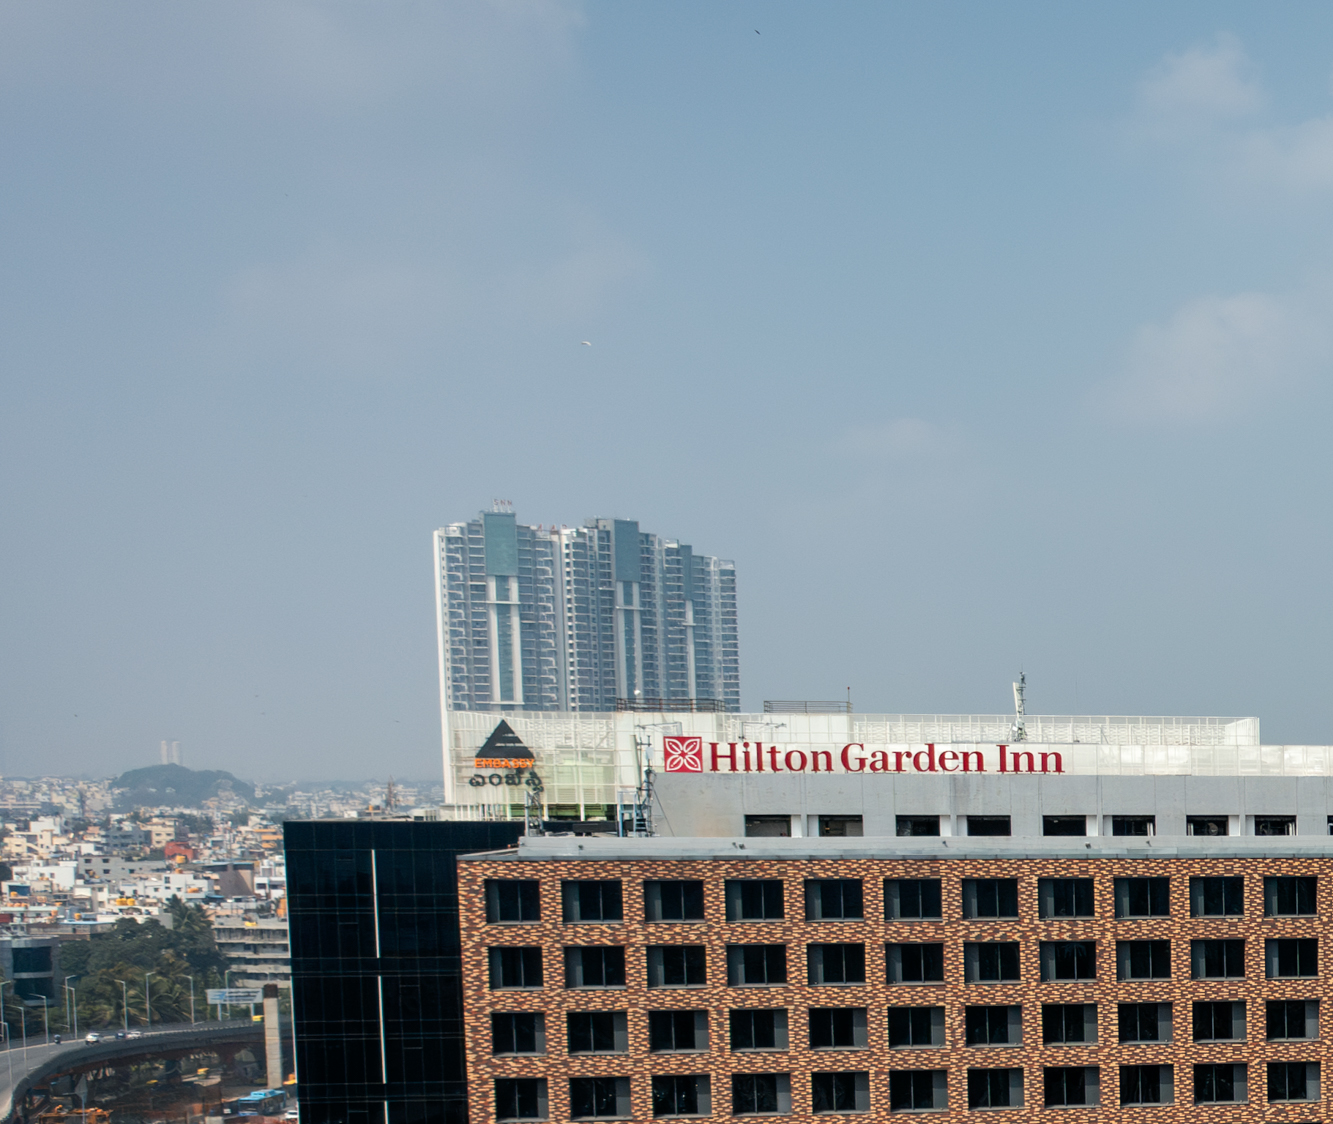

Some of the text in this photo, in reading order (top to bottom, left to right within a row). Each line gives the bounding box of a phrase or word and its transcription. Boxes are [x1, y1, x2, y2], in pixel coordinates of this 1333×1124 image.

[475, 758, 535, 768] EMBASSY
[709, 741, 1065, 773] Hilton Garden Inn
